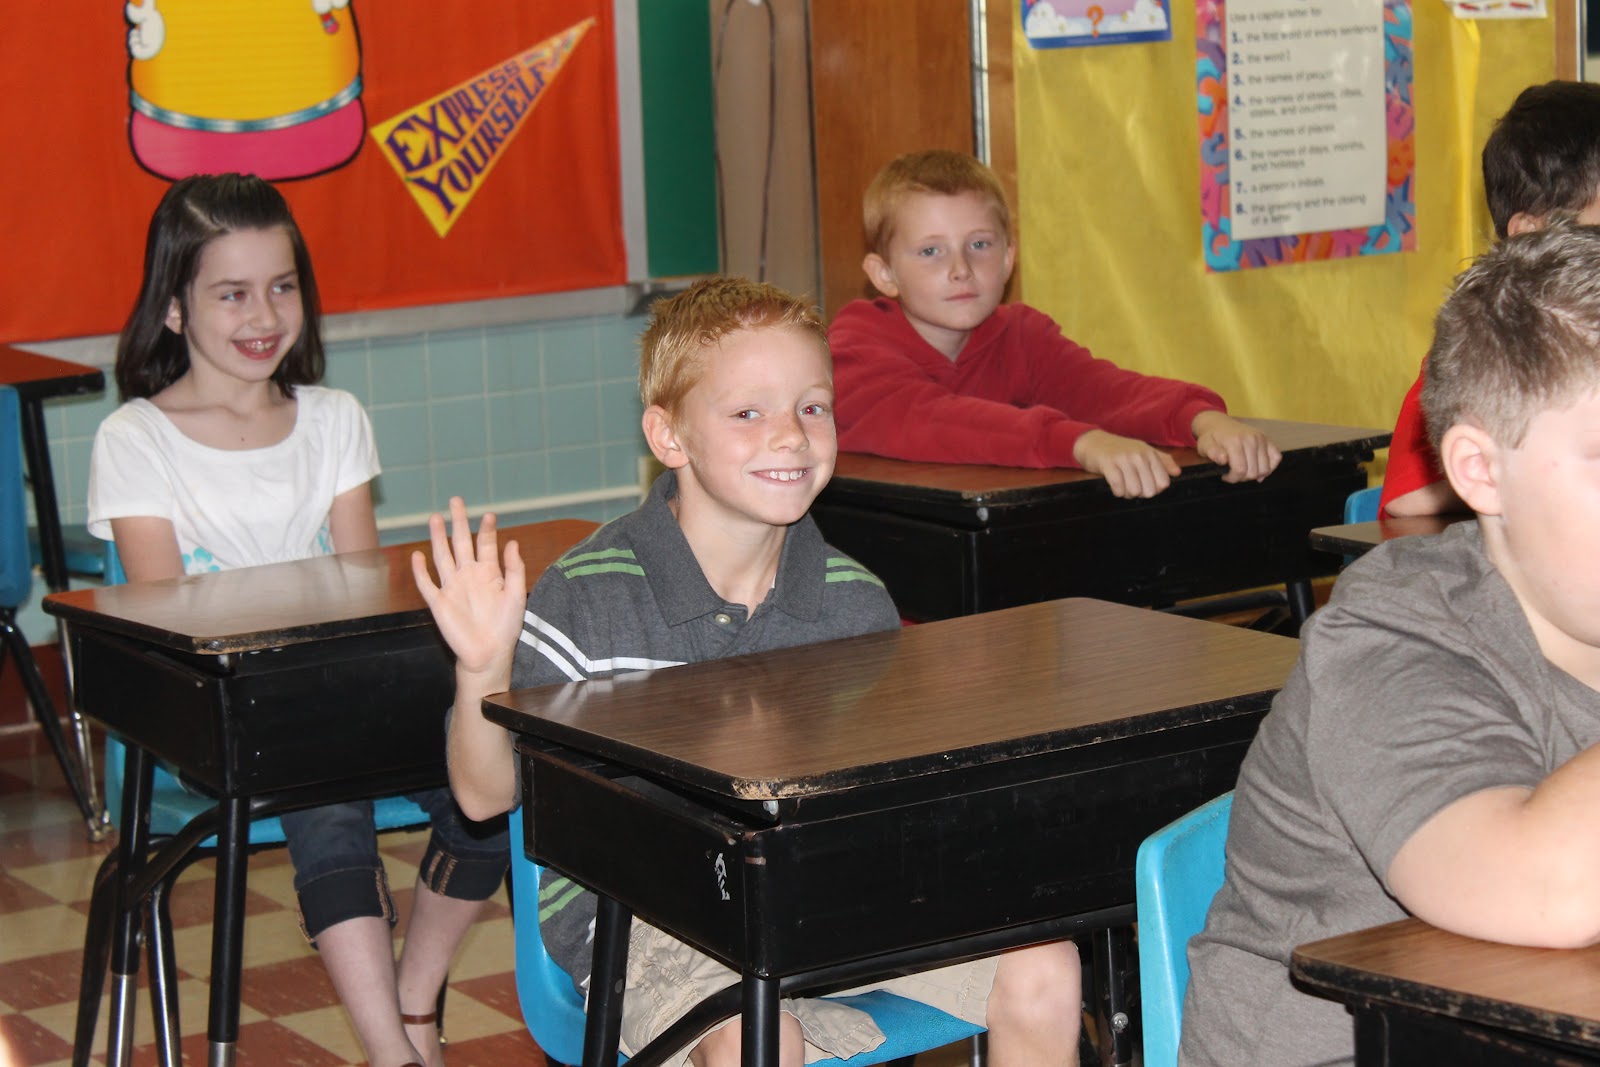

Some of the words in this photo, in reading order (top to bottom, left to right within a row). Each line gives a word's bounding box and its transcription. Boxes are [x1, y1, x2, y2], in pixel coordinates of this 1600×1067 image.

[1232, 31, 1243, 44] 1.
[1247, 32, 1260, 43] the
[1262, 30, 1279, 41] first
[1281, 29, 1301, 40] word
[1314, 28, 1337, 39] every
[1339, 25, 1378, 35] sentence
[1232, 51, 1243, 65] 2.
[1248, 53, 1261, 64] the
[1263, 52, 1285, 63] word
[1233, 73, 1244, 86] 3.
[1248, 73, 1262, 84] the
[1264, 73, 1293, 83] names
[1234, 95, 1245, 106] 4.
[1250, 95, 1263, 106] the
[1265, 94, 1294, 104] names
[384, 59, 521, 174] EXPRESS
[1281, 105, 1297, 116] and
[410, 61, 548, 215] YOURSELF
[1234, 127, 1247, 140] 5.
[1250, 128, 1264, 138] the
[1266, 127, 1295, 137] names
[1250, 150, 1264, 160] the
[1266, 149, 1296, 158] names
[1251, 162, 1268, 172] and
[1235, 180, 1247, 194] 7.
[1251, 204, 1266, 213] the
[1268, 200, 1301, 215] greeting
[1304, 198, 1321, 209] and
[1322, 196, 1336, 206] the
